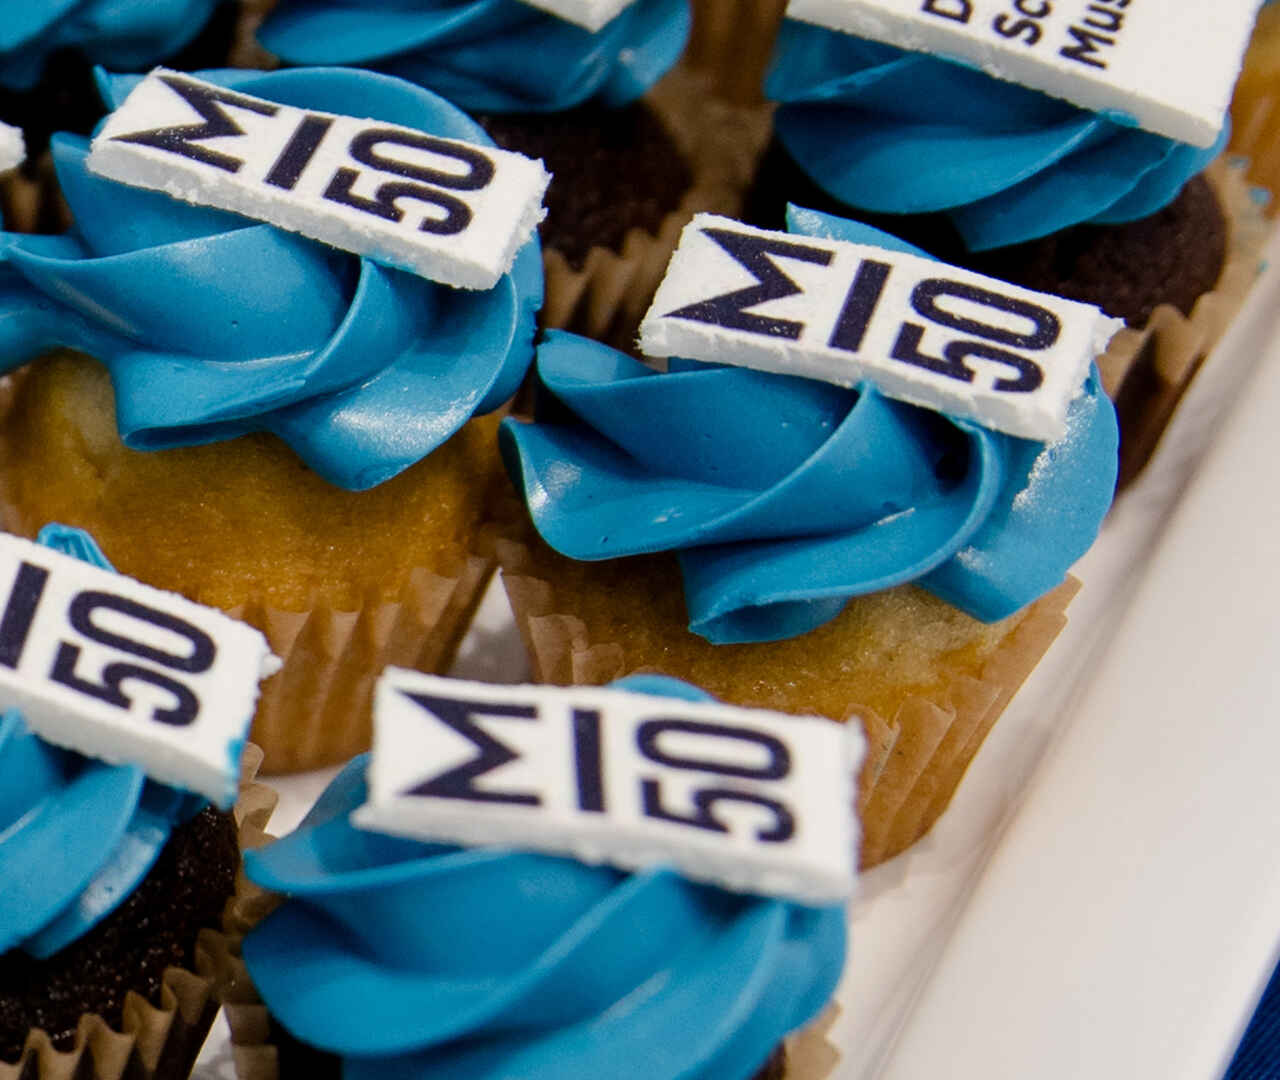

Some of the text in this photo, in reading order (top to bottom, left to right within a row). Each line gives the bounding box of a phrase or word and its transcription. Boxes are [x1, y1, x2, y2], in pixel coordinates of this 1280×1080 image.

[323, 128, 497, 236] 50
[890, 278, 1062, 394] 50
[49, 591, 217, 726] 50
[635, 717, 796, 844] 50
